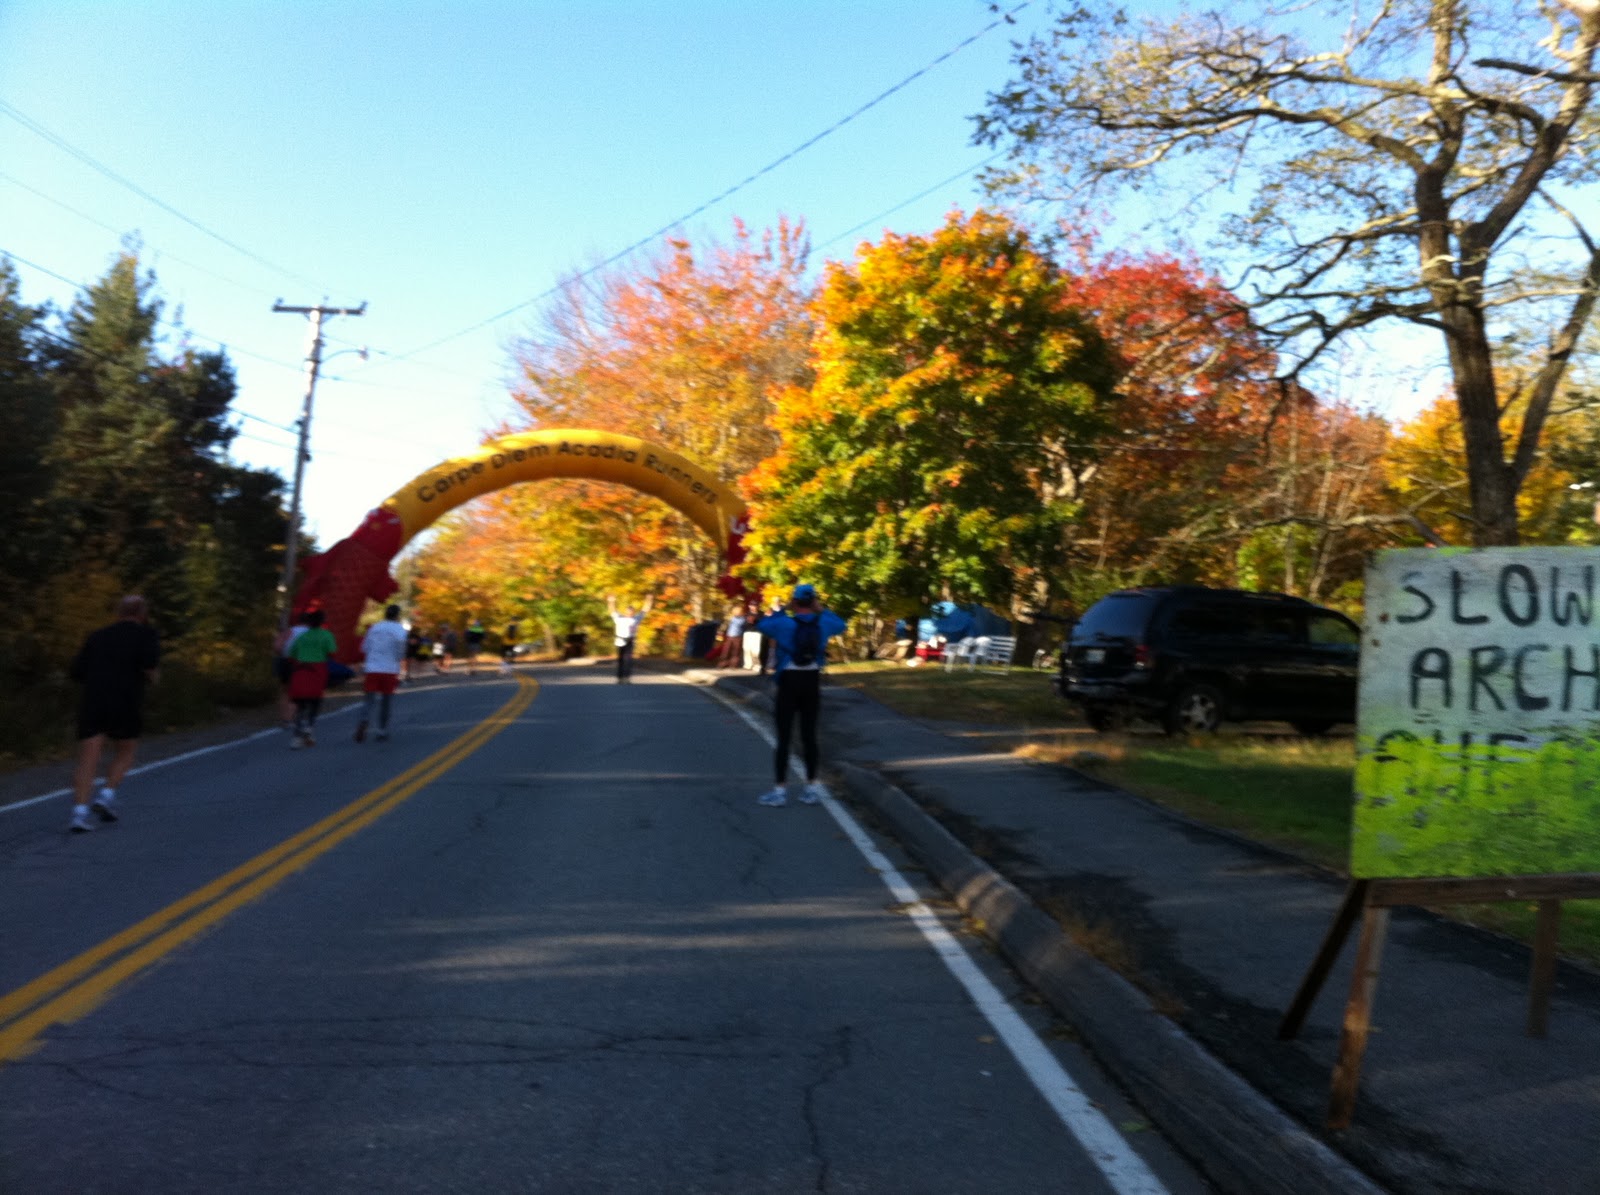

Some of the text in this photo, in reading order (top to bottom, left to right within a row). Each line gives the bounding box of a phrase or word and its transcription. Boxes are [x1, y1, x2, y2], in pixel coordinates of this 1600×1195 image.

[418, 440, 717, 504] Carpe Diem Acadia Runners
[1396, 564, 1594, 627] SLOW
[1410, 645, 1600, 711] ARCH
